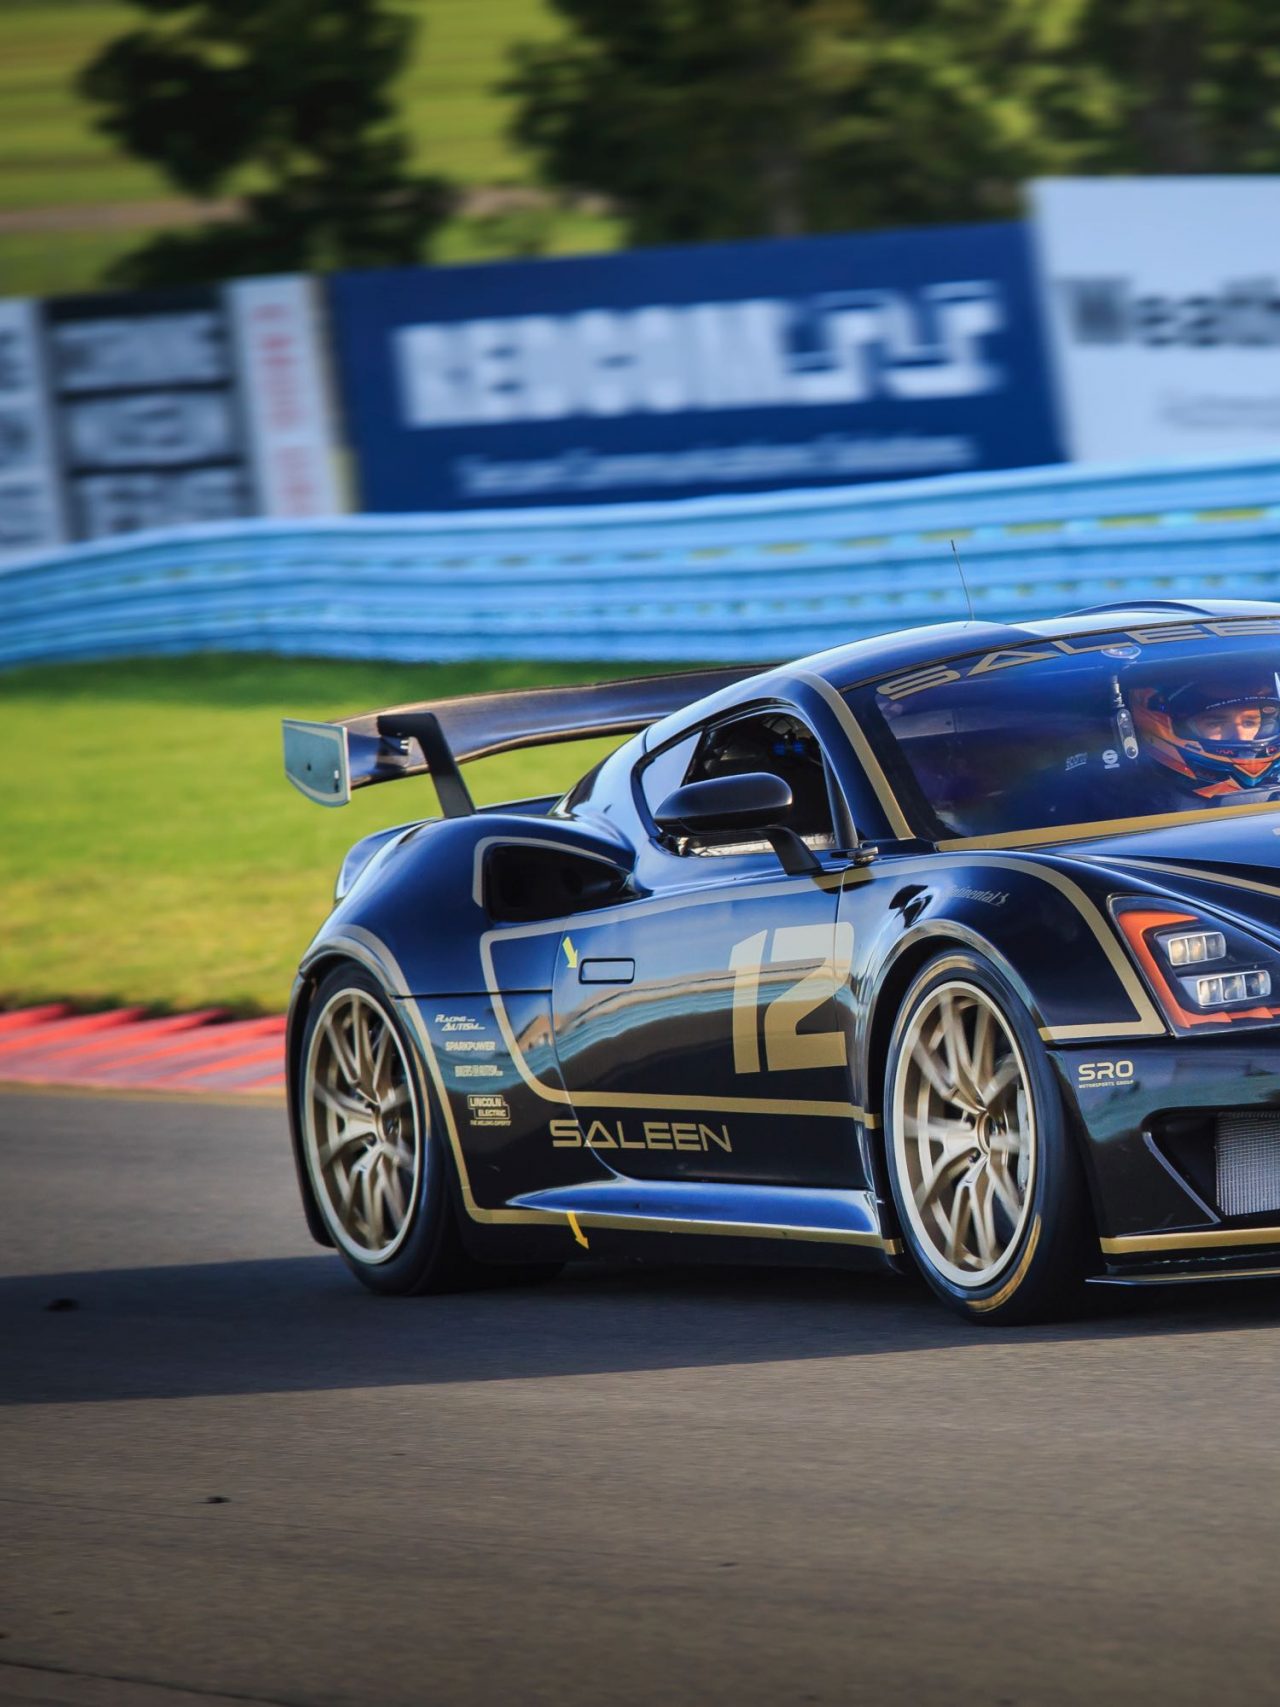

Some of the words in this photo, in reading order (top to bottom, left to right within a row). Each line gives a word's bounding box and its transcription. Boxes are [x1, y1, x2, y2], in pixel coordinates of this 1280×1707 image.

[727, 921, 855, 1074] 12
[1078, 1060, 1134, 1081] SRO
[469, 1097, 503, 1107] LINCOLN
[478, 1108, 507, 1117] ELECTRIC
[549, 1119, 733, 1153] SALEEN
